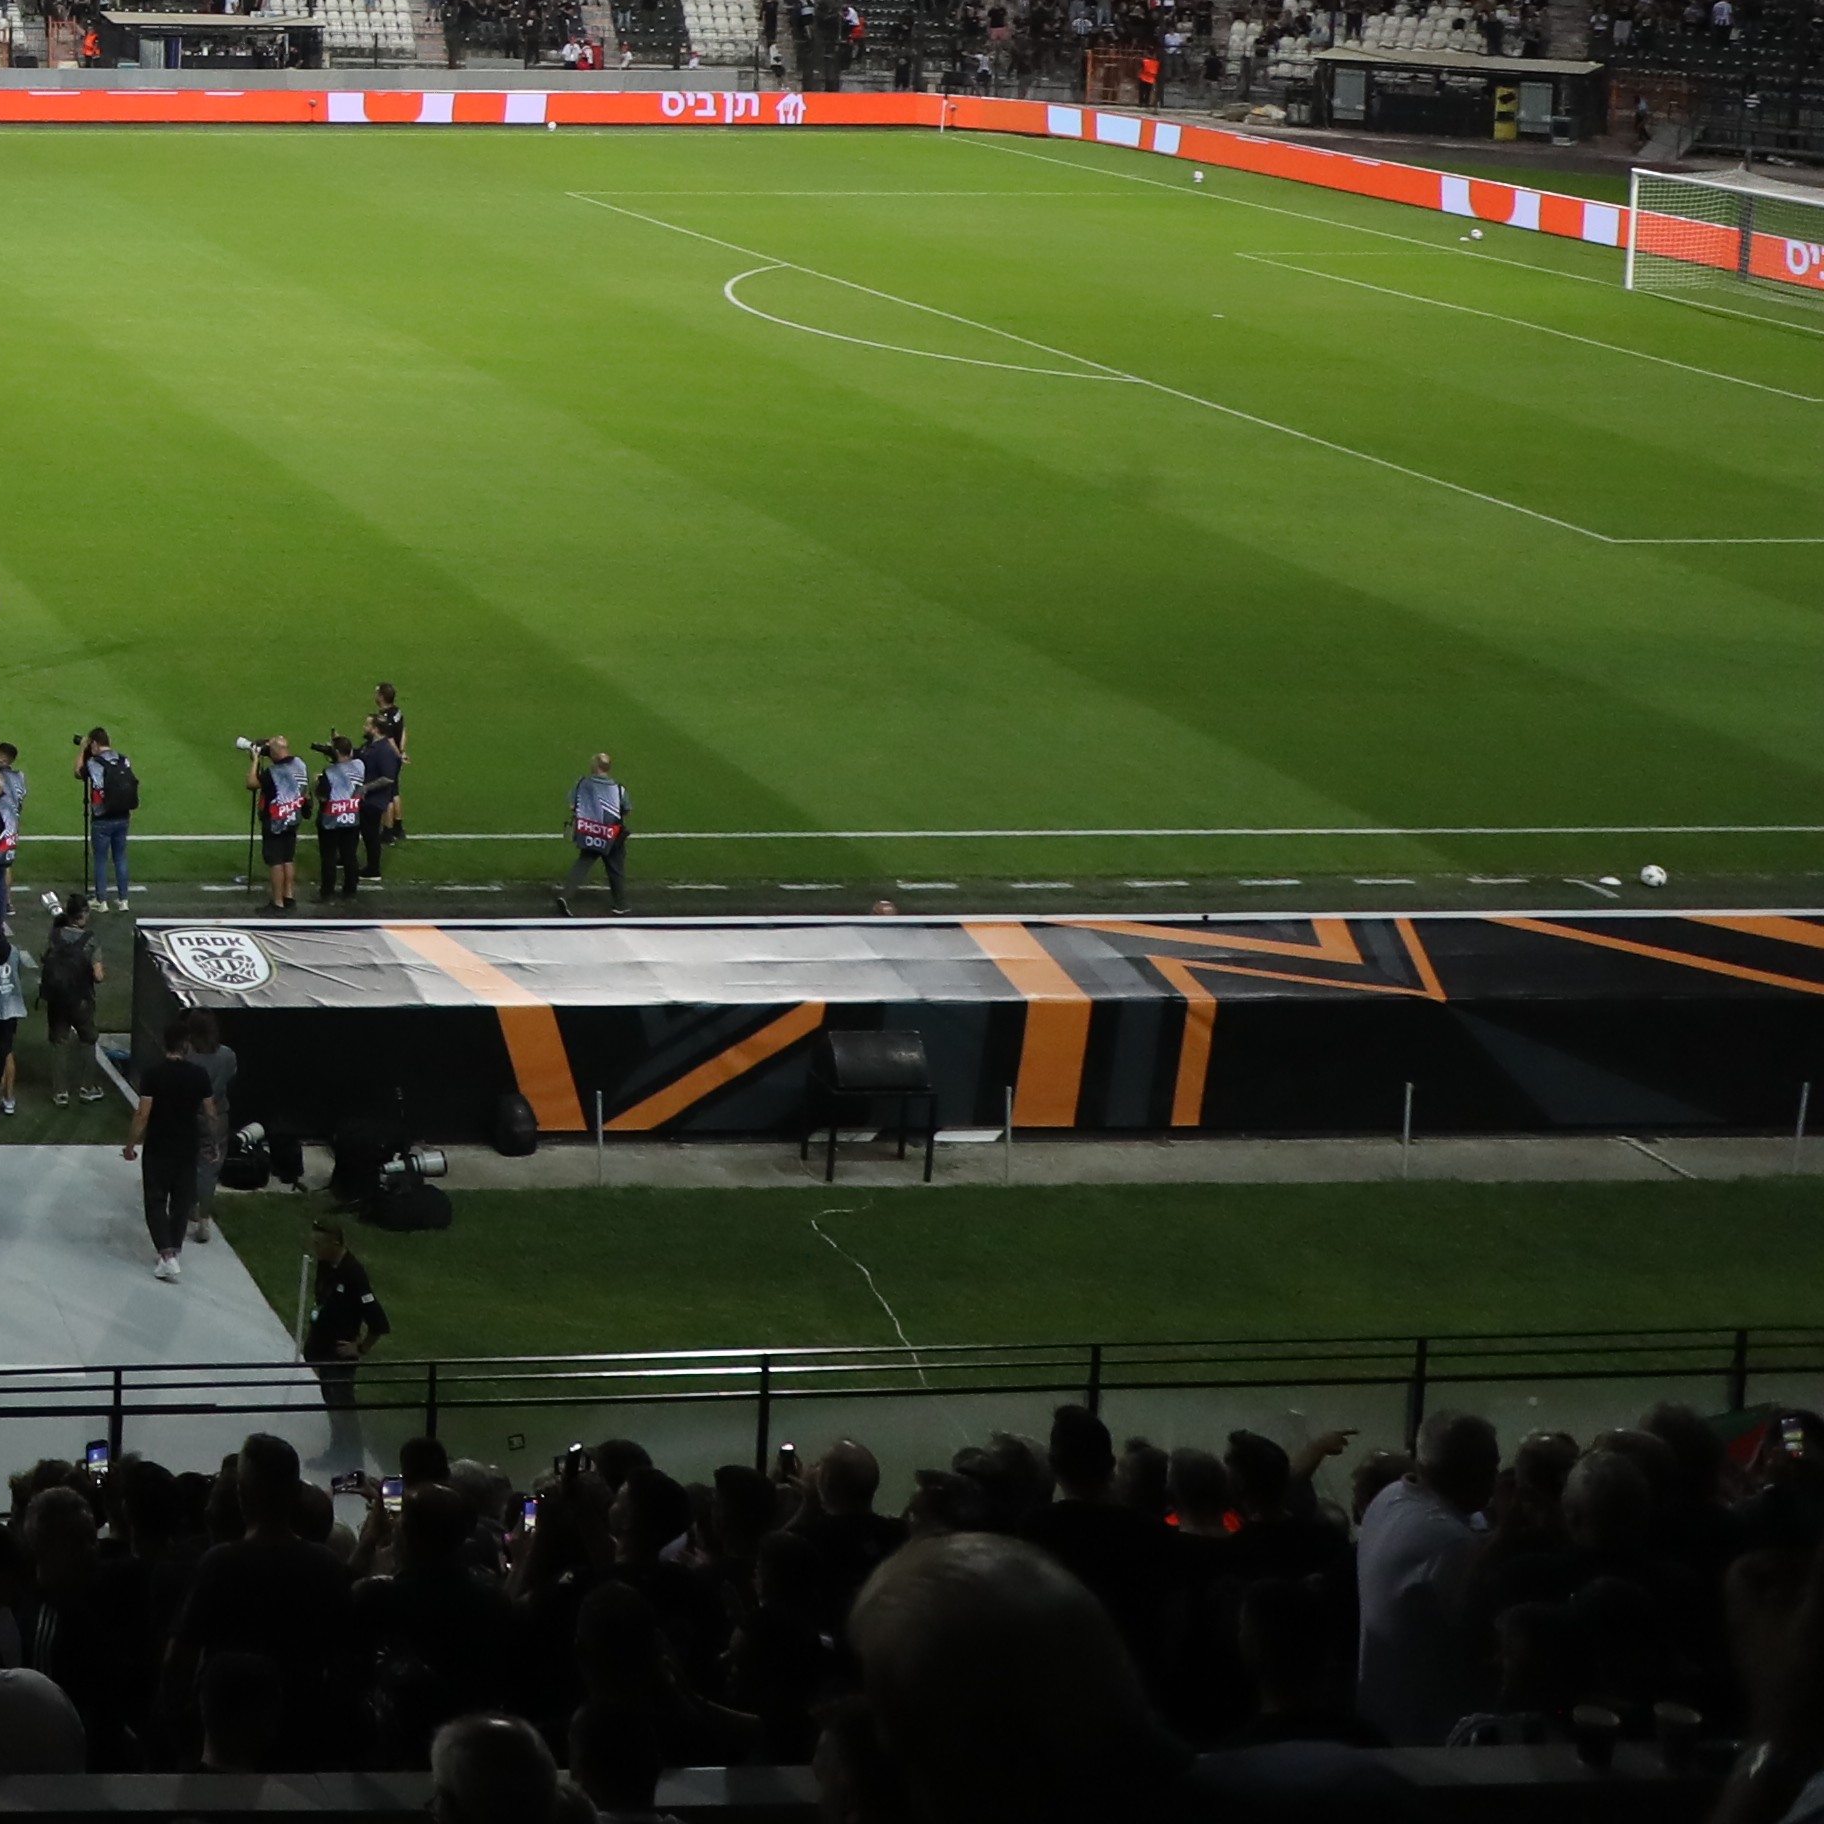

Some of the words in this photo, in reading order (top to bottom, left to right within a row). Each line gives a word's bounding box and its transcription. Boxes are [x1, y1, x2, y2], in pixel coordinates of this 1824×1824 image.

[661, 93, 717, 117] ביס
[723, 93, 760, 124] תן
[337, 812, 356, 824] 08
[577, 819, 614, 839] PHOTO
[585, 835, 607, 849] 007
